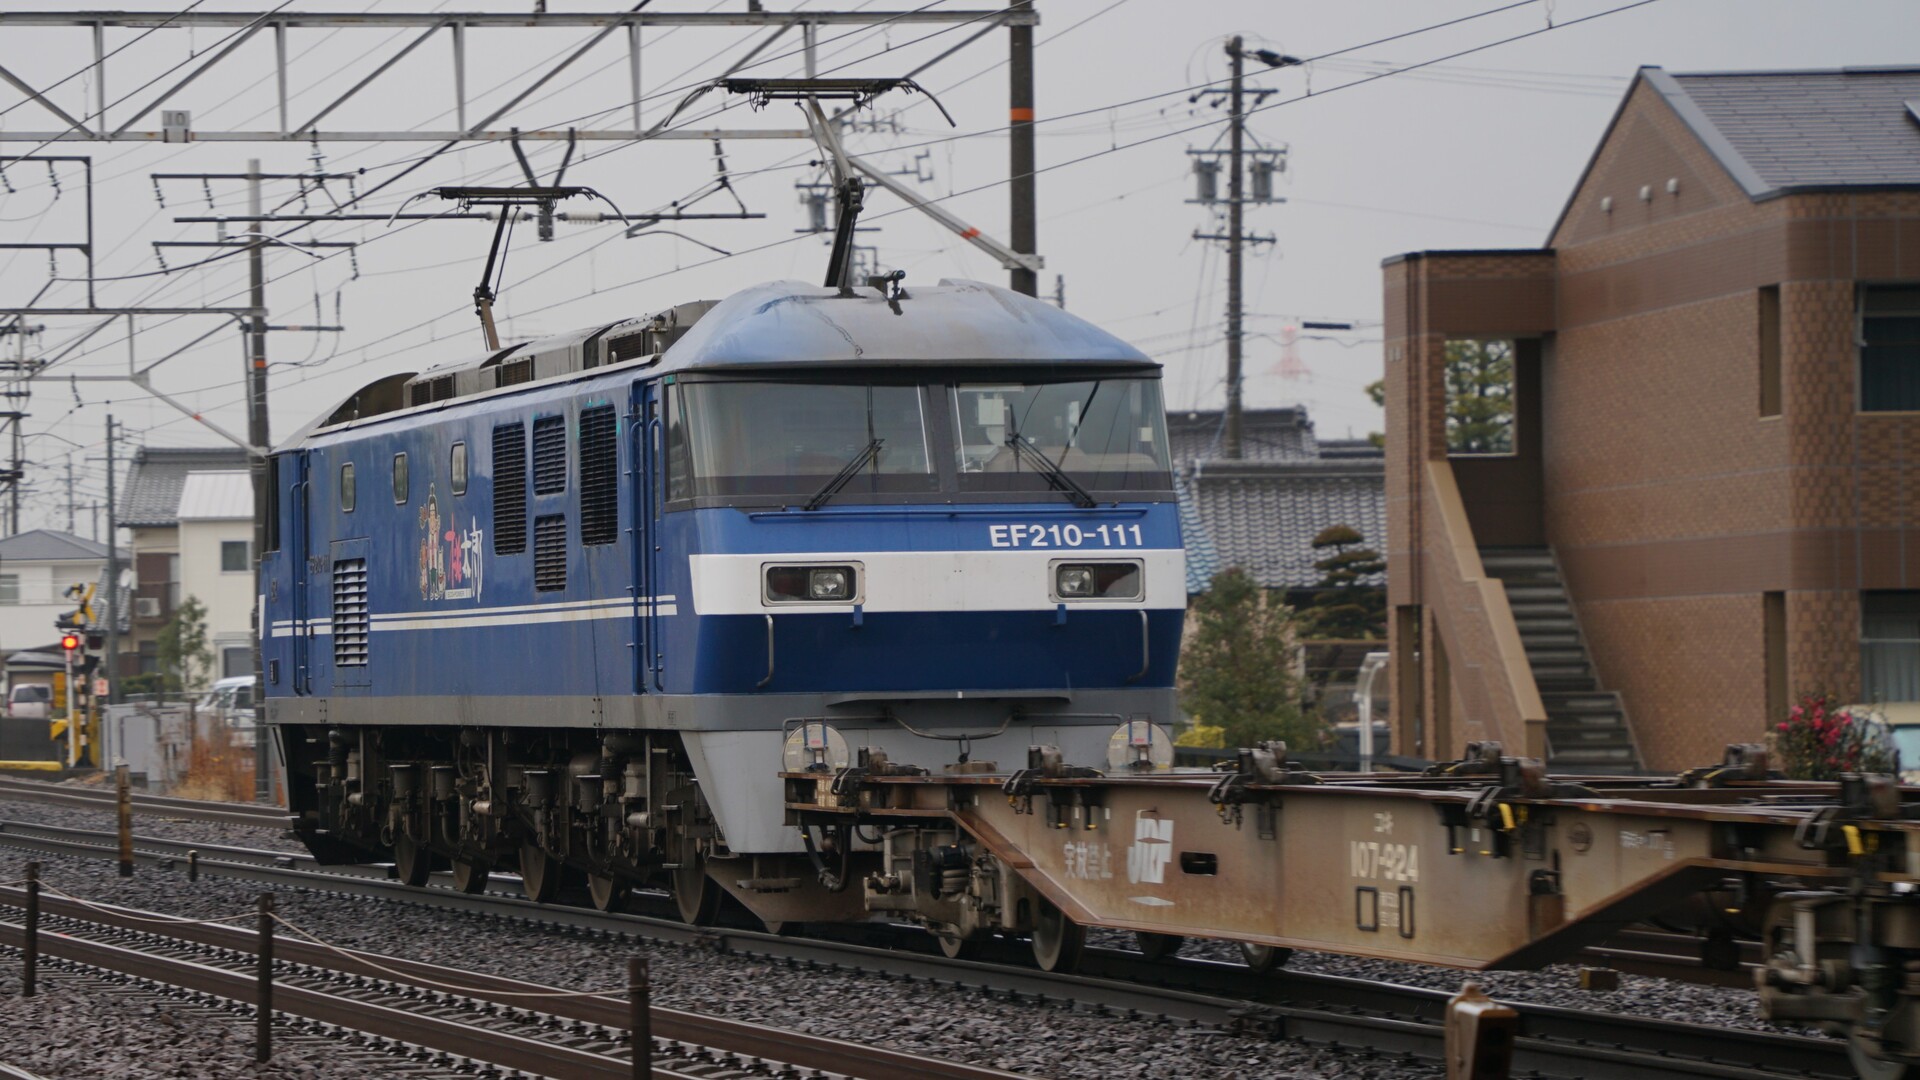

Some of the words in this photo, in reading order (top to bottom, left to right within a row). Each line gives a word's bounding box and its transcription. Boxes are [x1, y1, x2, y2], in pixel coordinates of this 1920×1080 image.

[989, 524, 1143, 547] EF210-111
[444, 511, 483, 603] 桃太郎
[1373, 811, 1394, 834] コキ
[1350, 841, 1419, 881] 107-924
